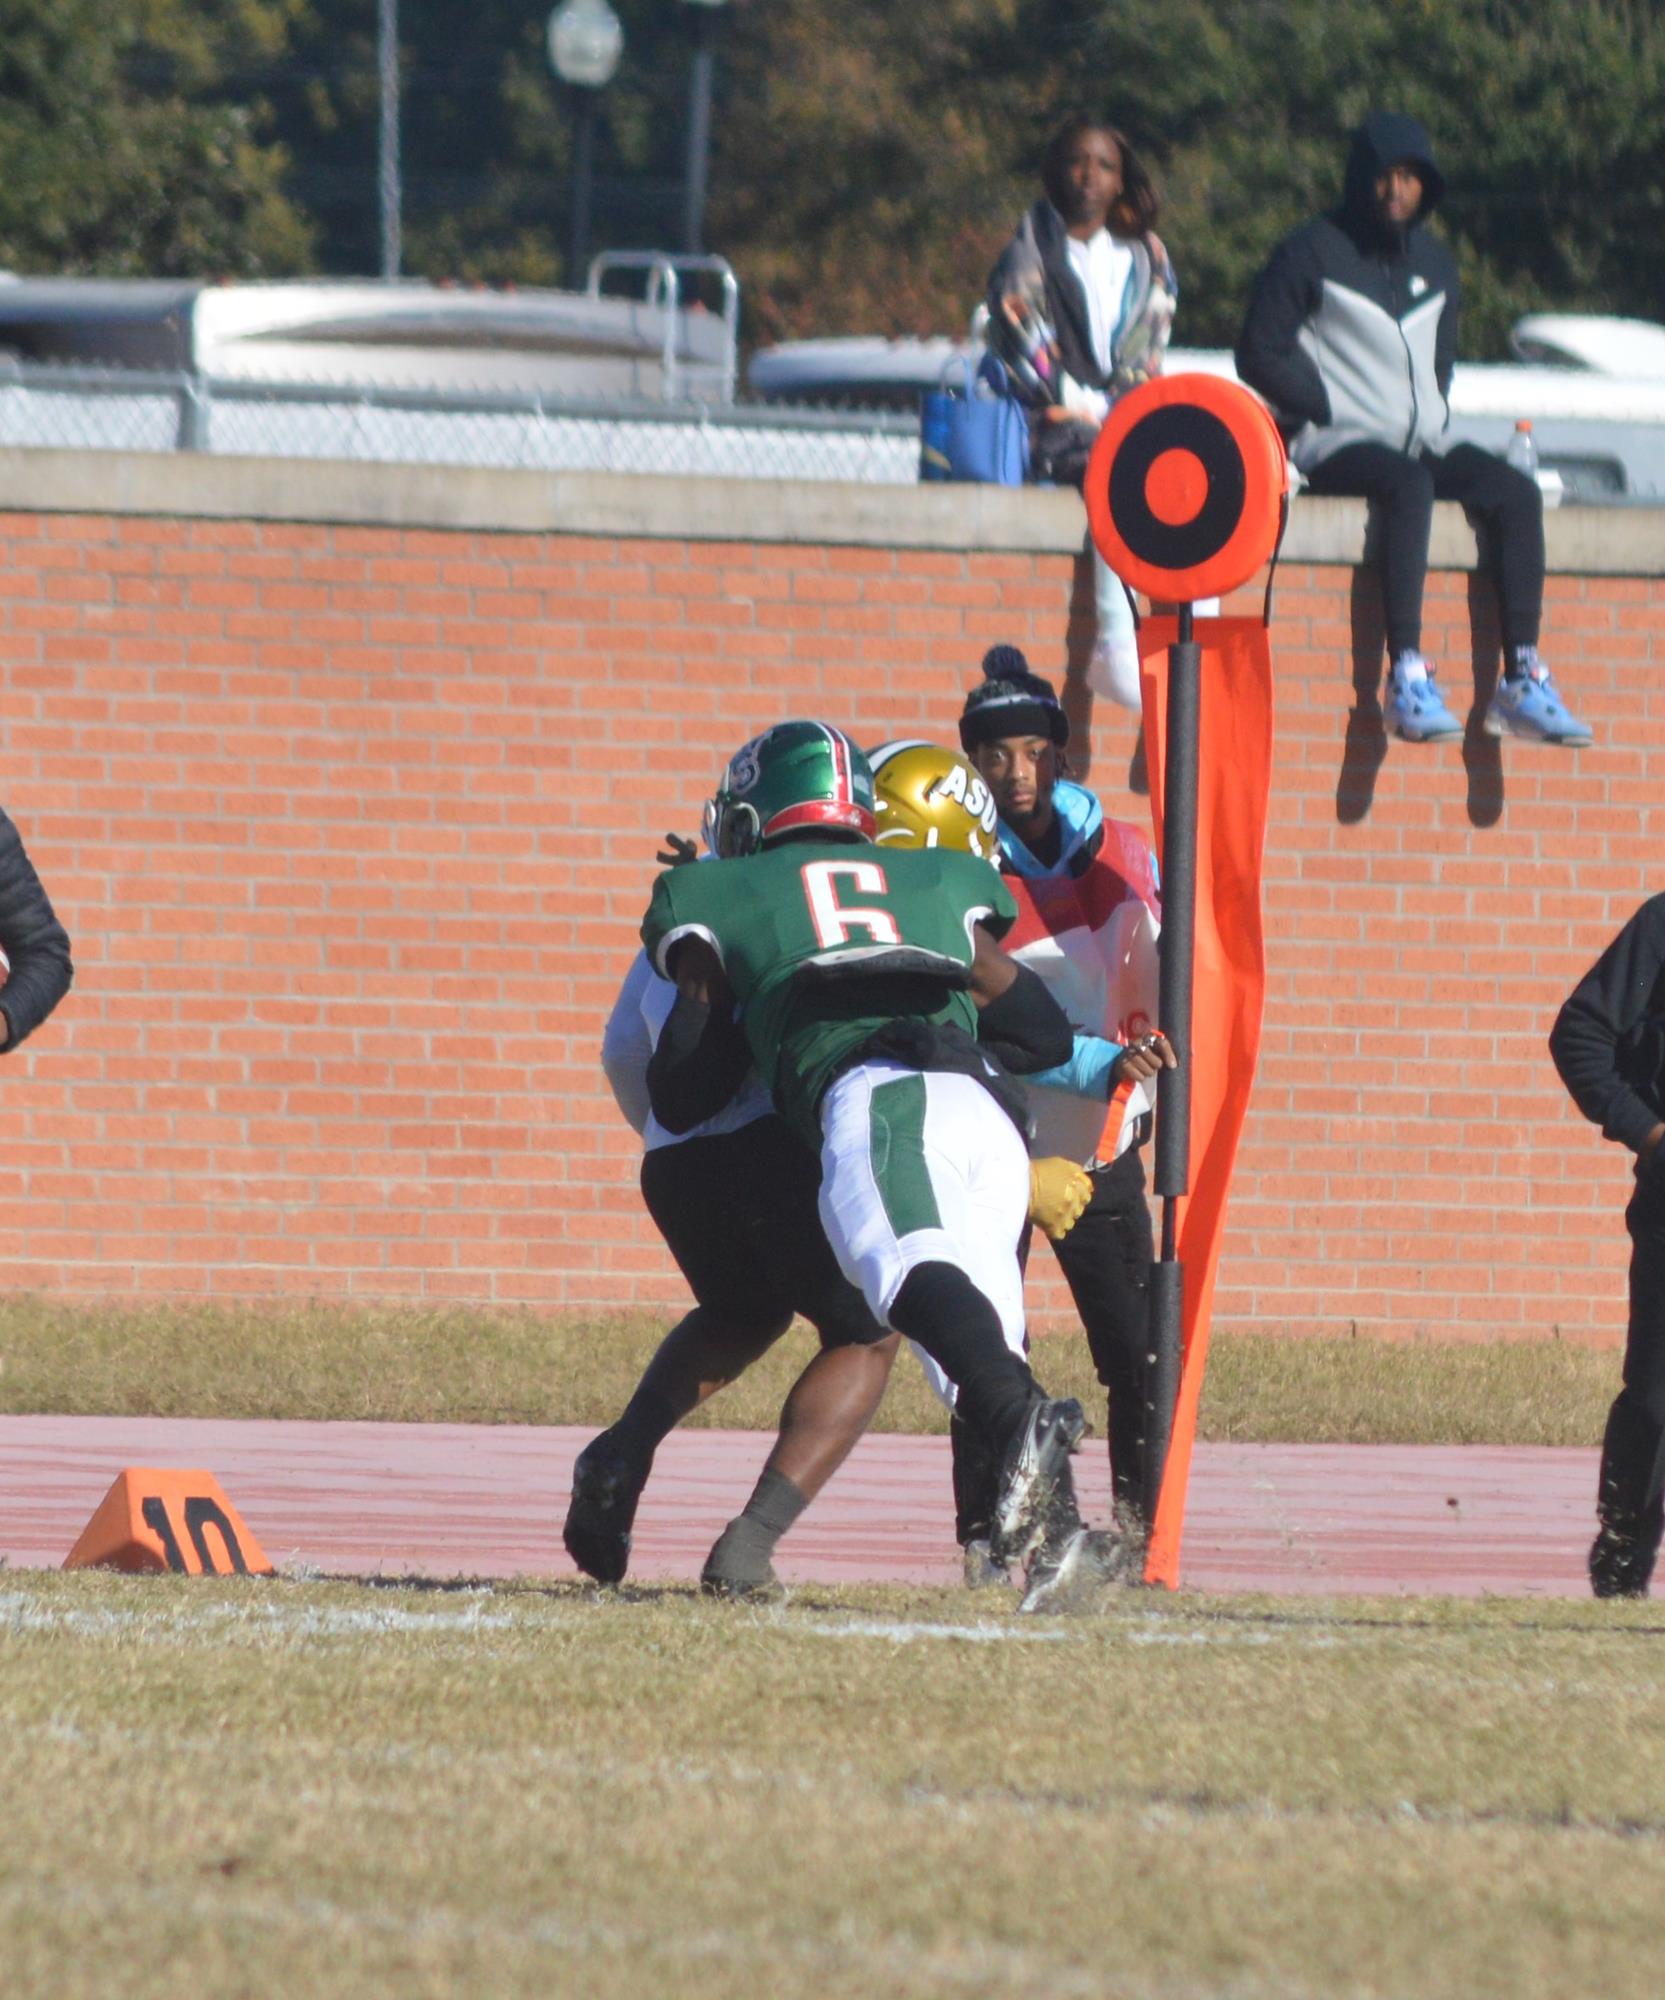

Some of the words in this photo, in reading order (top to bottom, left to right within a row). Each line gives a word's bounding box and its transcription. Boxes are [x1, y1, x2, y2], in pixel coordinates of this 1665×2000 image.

[935, 764, 998, 835] ASU
[801, 860, 902, 951] 6
[142, 1496, 249, 1575] 10
